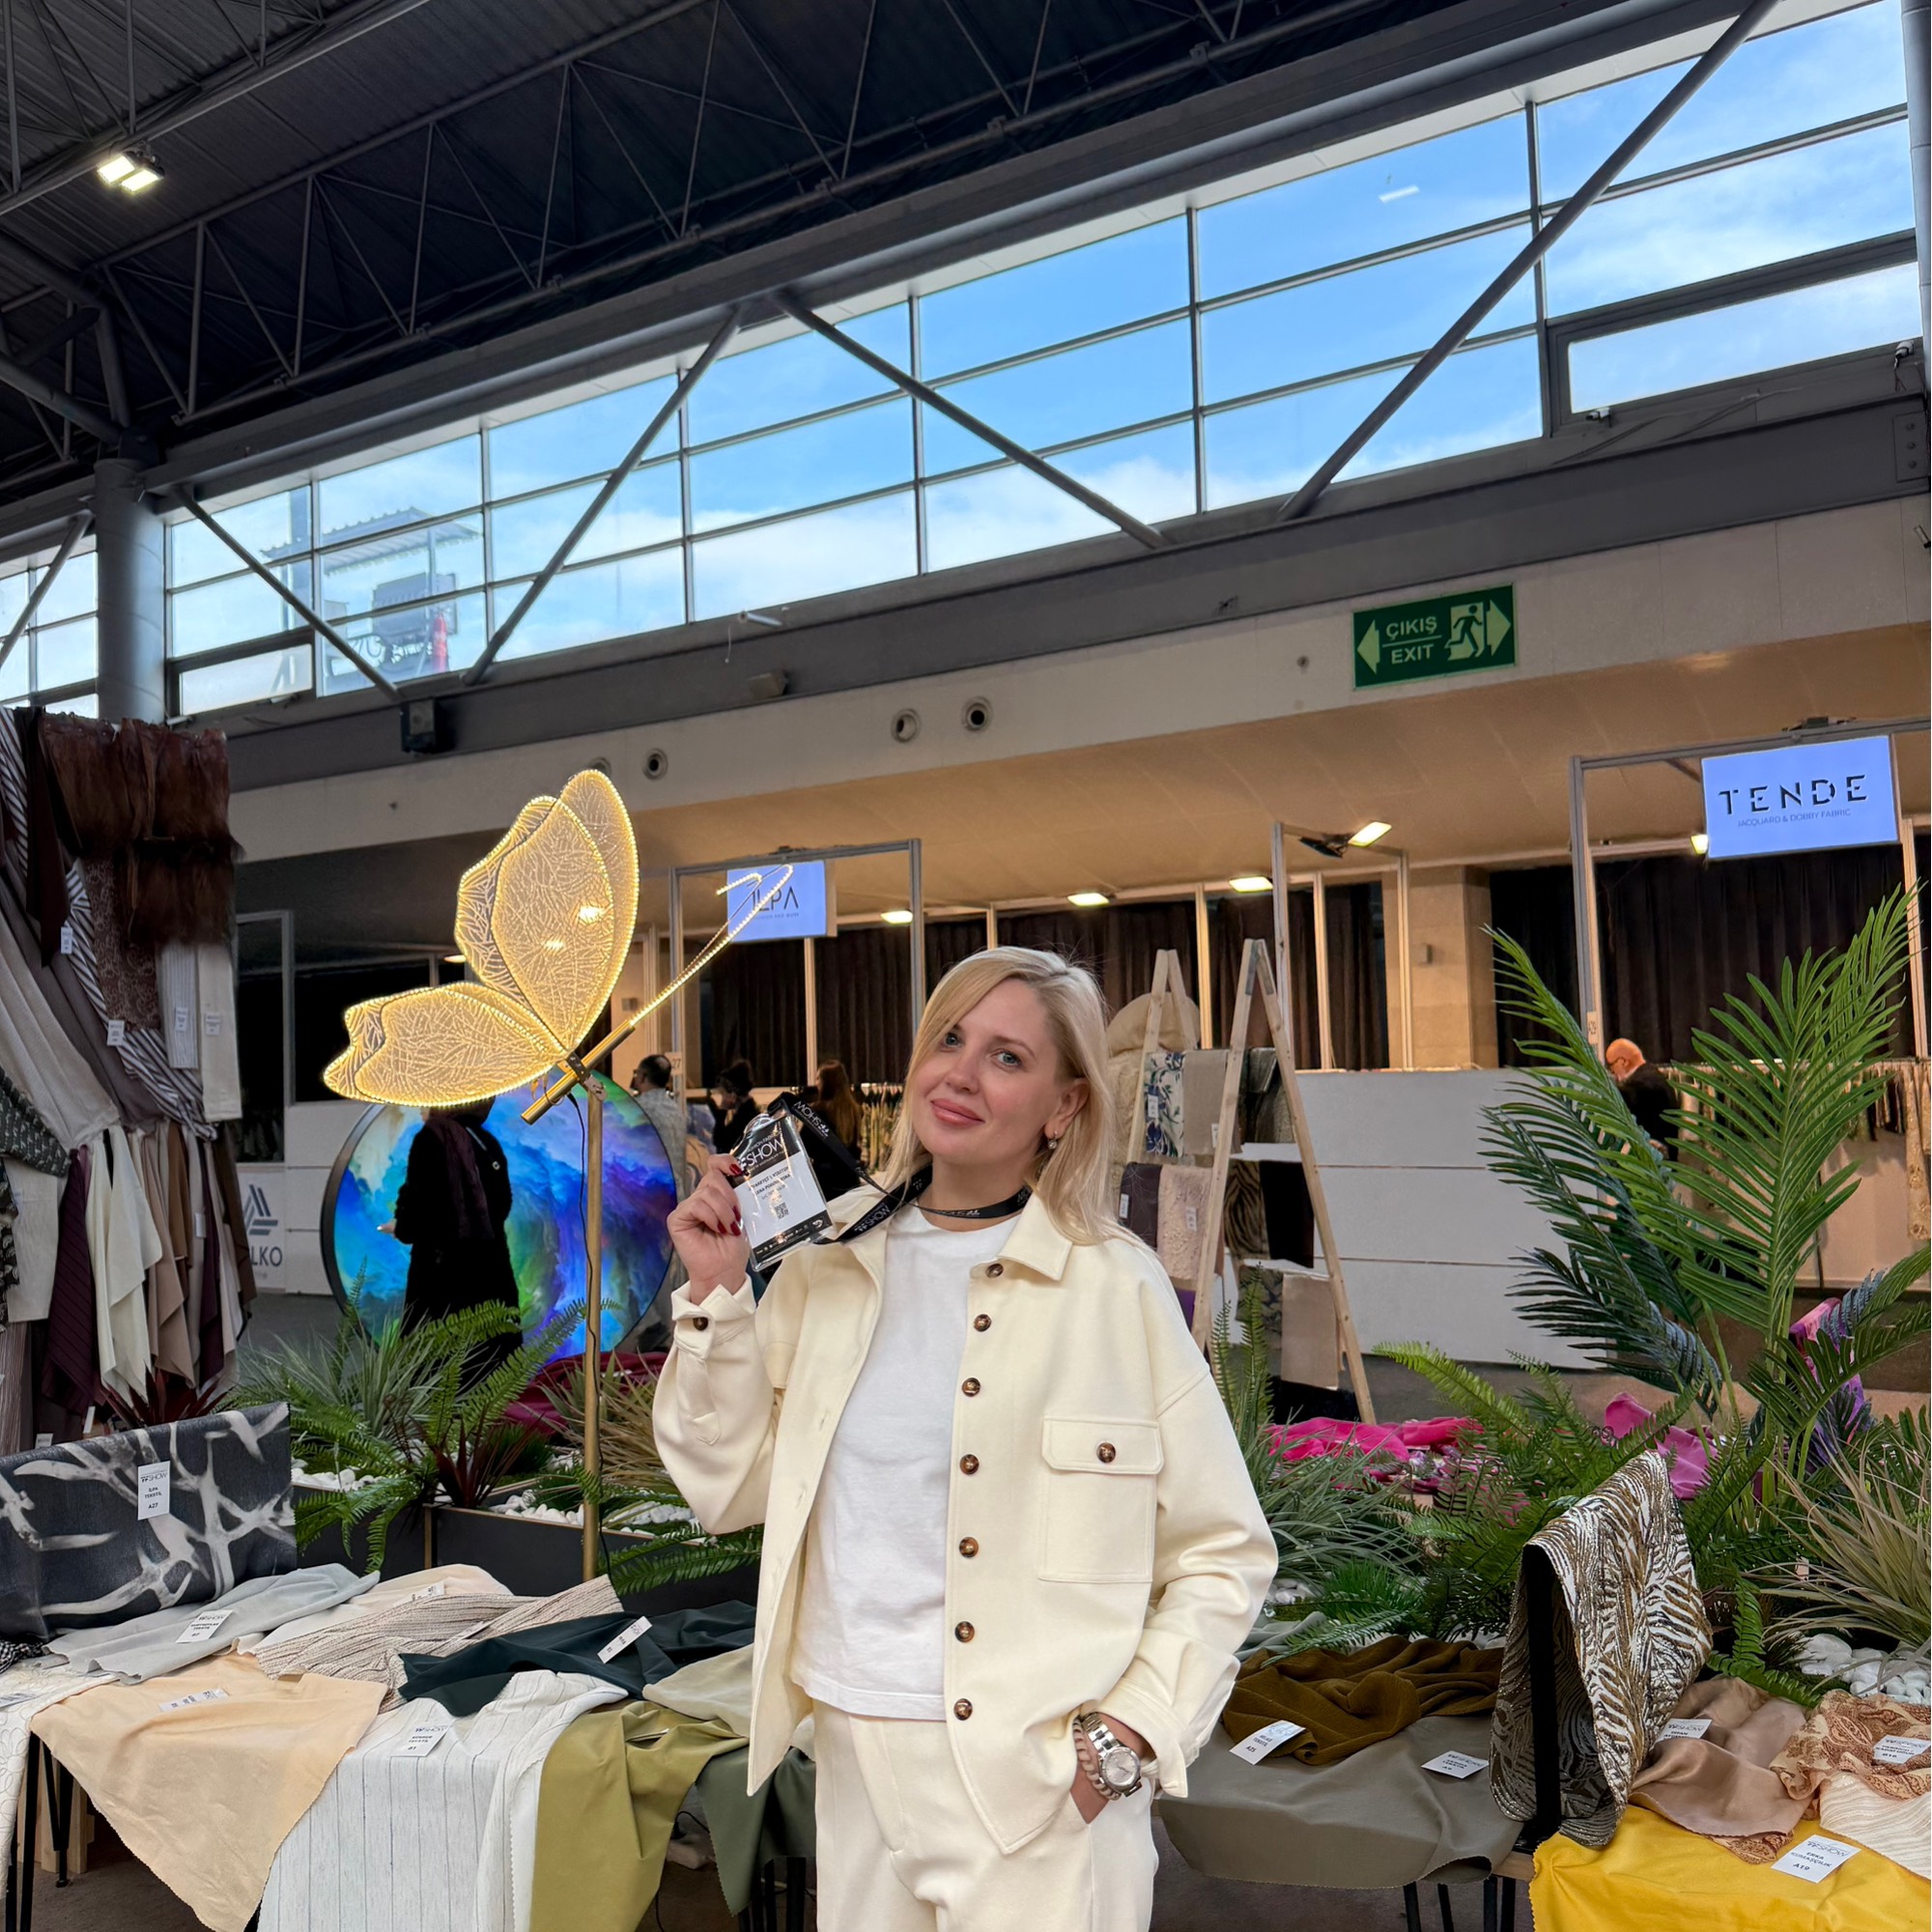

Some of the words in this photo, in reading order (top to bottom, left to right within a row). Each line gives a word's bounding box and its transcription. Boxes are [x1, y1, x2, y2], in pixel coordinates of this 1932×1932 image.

[1385, 615, 1438, 640] ÇIKIŞ
[1391, 643, 1435, 666] EXIT
[1719, 774, 1868, 815] TENDE
[1738, 815, 1781, 828] JACQUARD
[1781, 814, 1789, 823] &
[1821, 808, 1851, 819] FABRIC
[670, 1058, 681, 1068] 27
[1806, 1851, 1825, 1861] ERKA
[1793, 1862, 1810, 1871] A19
